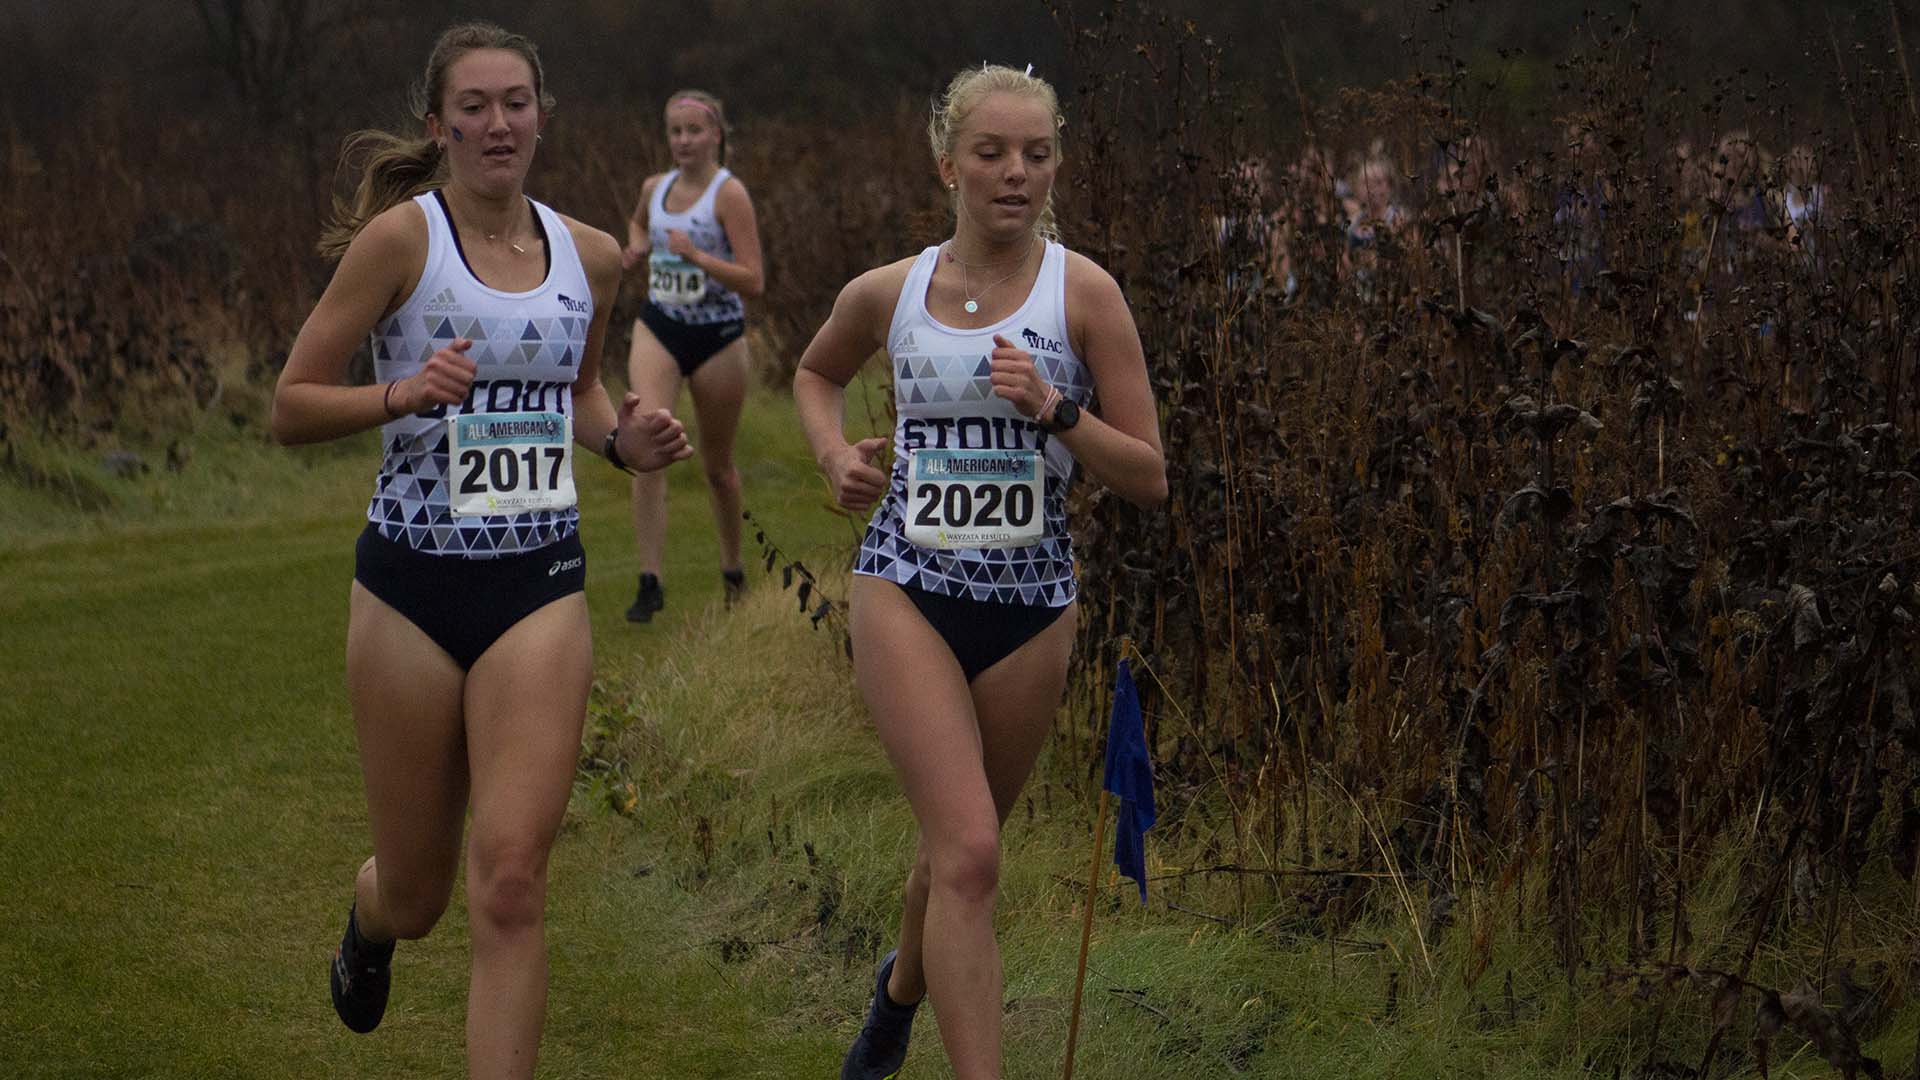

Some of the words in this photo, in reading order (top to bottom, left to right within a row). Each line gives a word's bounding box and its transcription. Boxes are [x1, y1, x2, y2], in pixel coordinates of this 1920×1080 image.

[1026, 335, 1063, 354] WIAC
[488, 420, 543, 438] AMERICAN
[459, 447, 565, 494] 2017
[945, 457, 1005, 474] AMERICAN
[914, 483, 1035, 528] 2020
